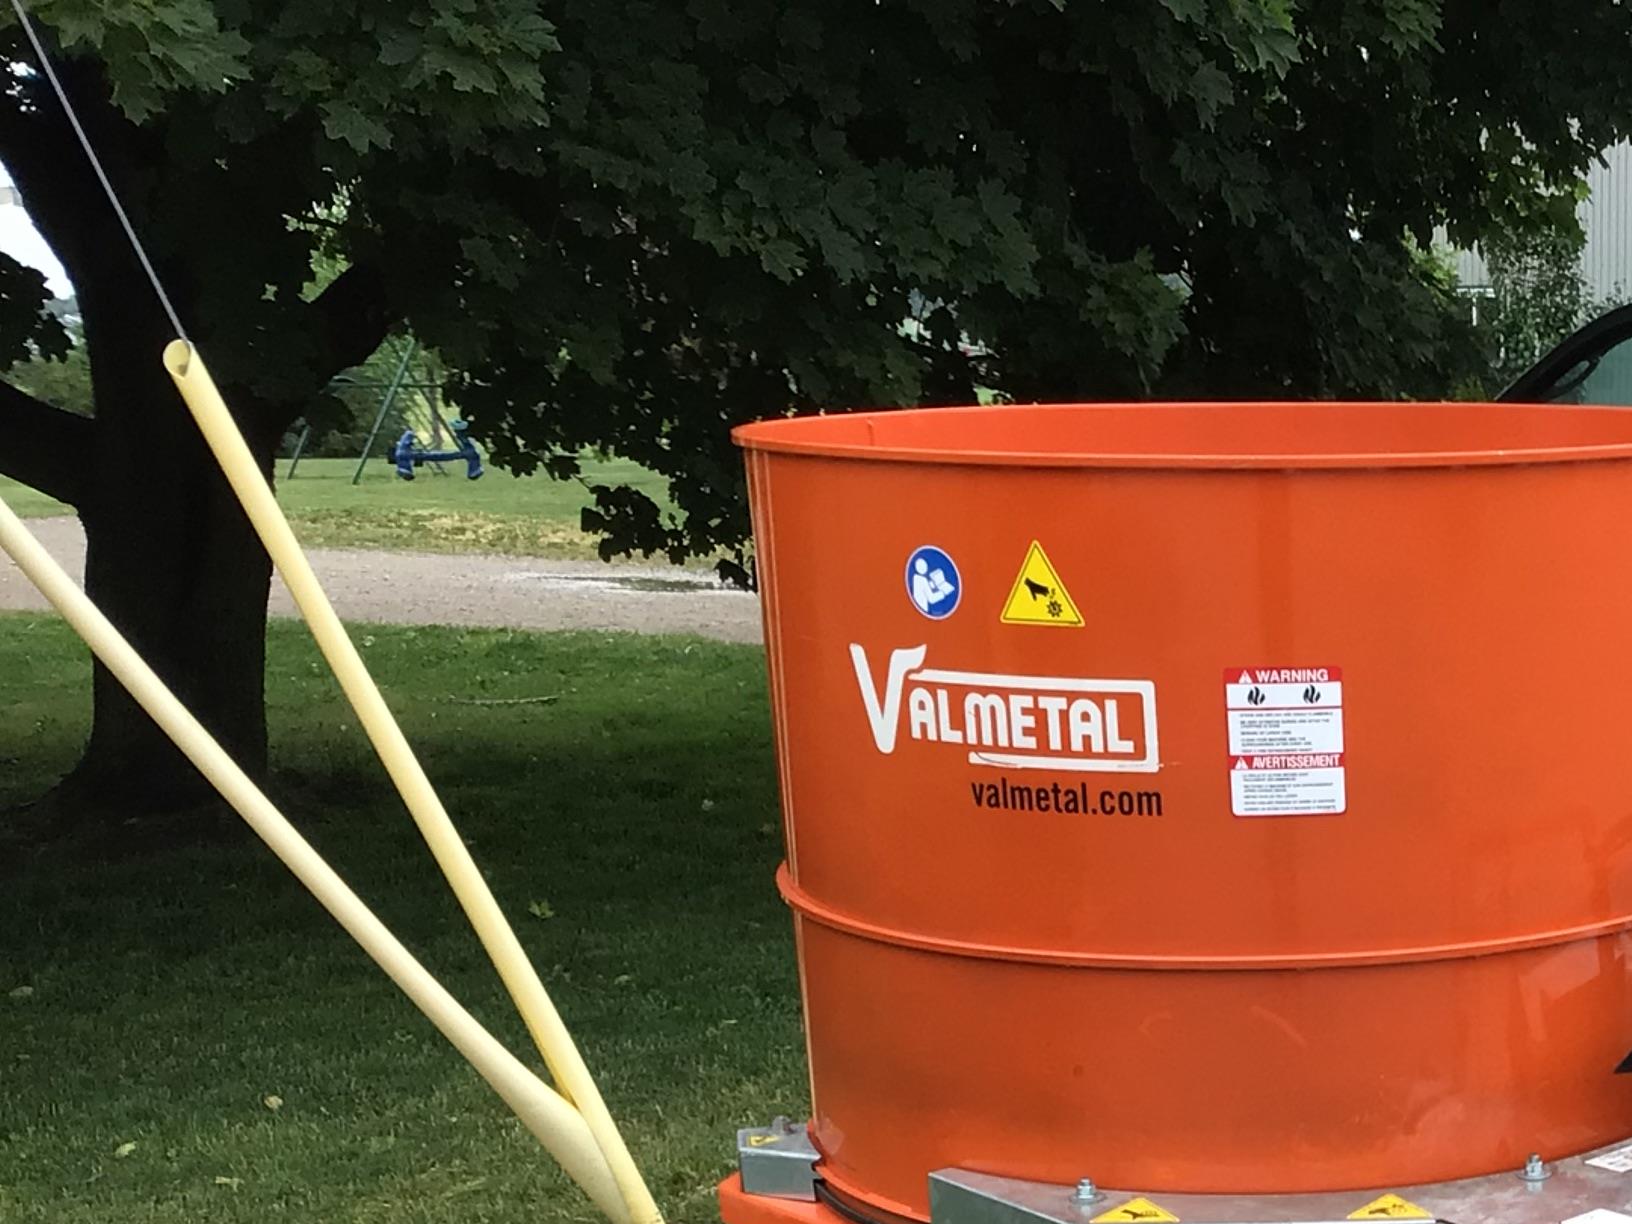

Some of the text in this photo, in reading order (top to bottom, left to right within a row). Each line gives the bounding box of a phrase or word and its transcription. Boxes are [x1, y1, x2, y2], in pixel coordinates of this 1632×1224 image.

[1255, 667, 1329, 684] WARNING
[849, 642, 1136, 755] VALMETAL
[1251, 753, 1341, 769] AVERTISSEMENT
[970, 776, 1164, 817] valmetal.com
